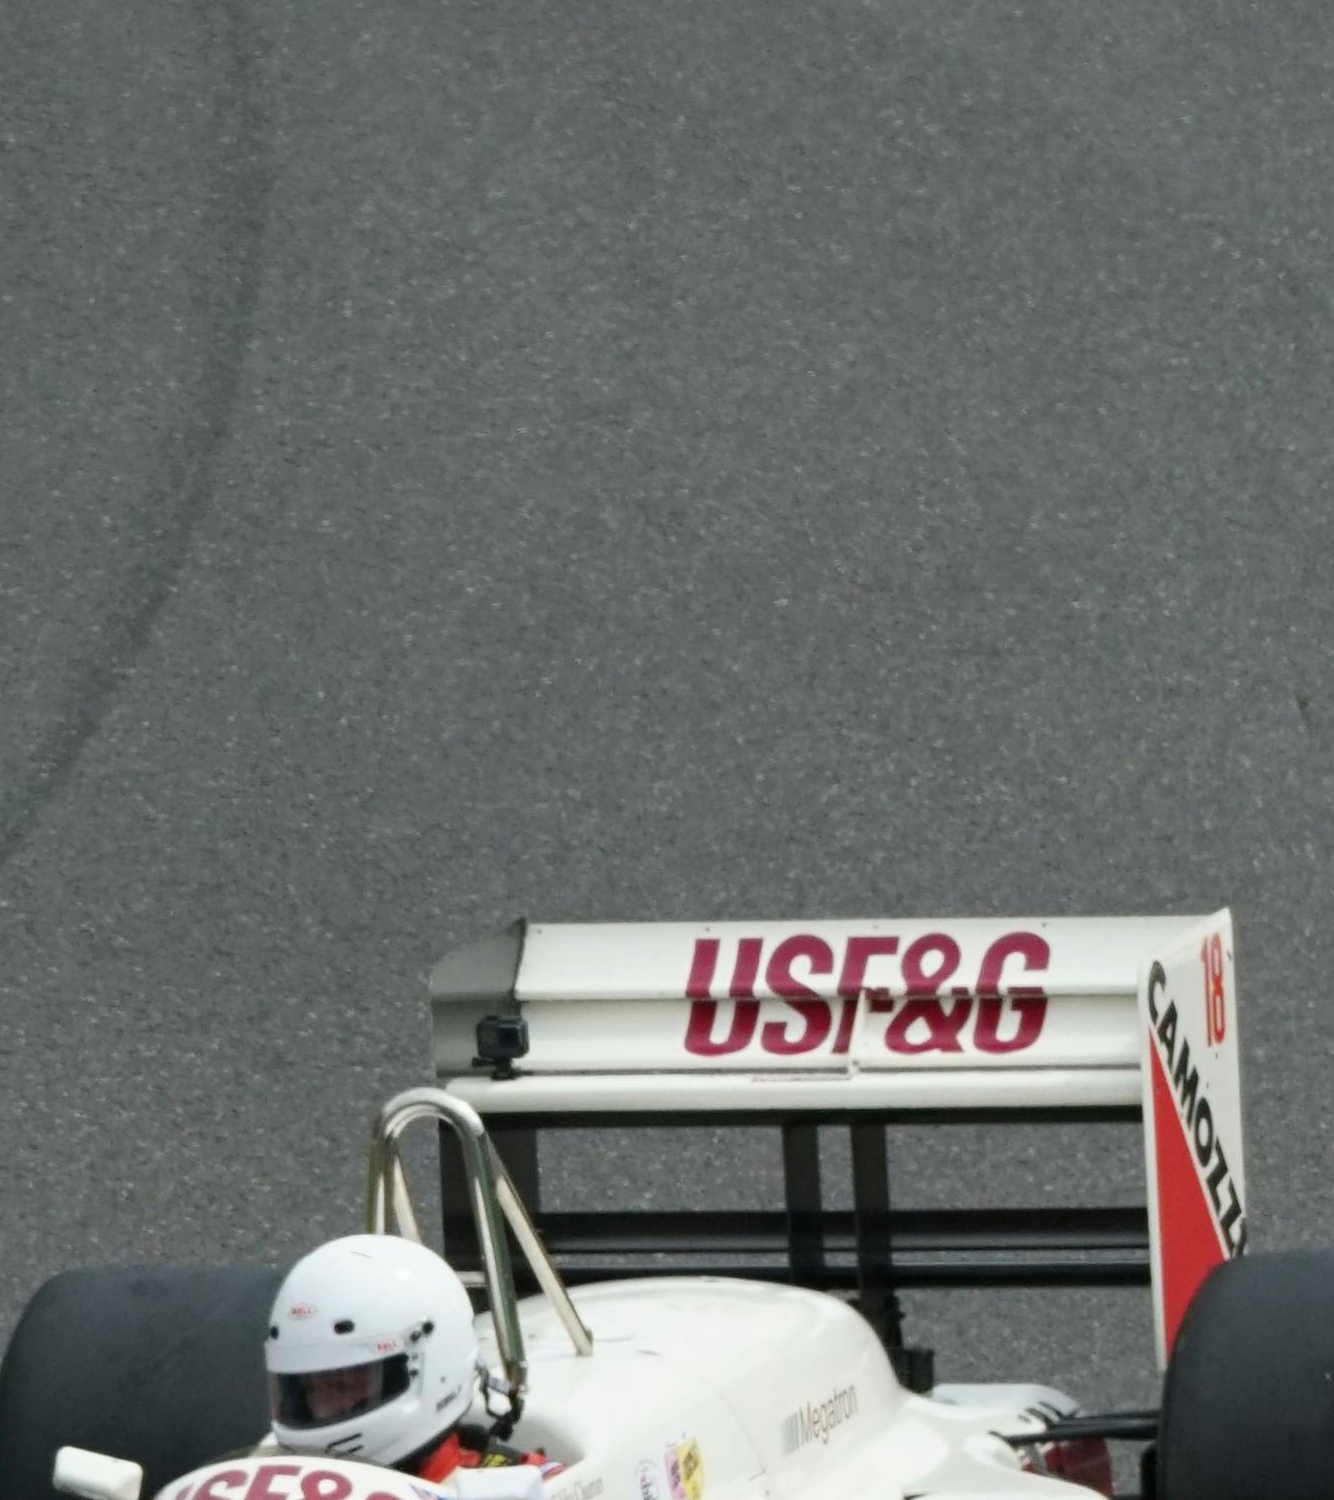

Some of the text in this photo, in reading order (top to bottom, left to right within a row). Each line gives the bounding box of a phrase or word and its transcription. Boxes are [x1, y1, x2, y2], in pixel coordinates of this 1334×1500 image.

[684, 932, 1050, 1056] USF&G
[1201, 933, 1225, 1047] 18
[799, 1384, 858, 1444] Megatron
